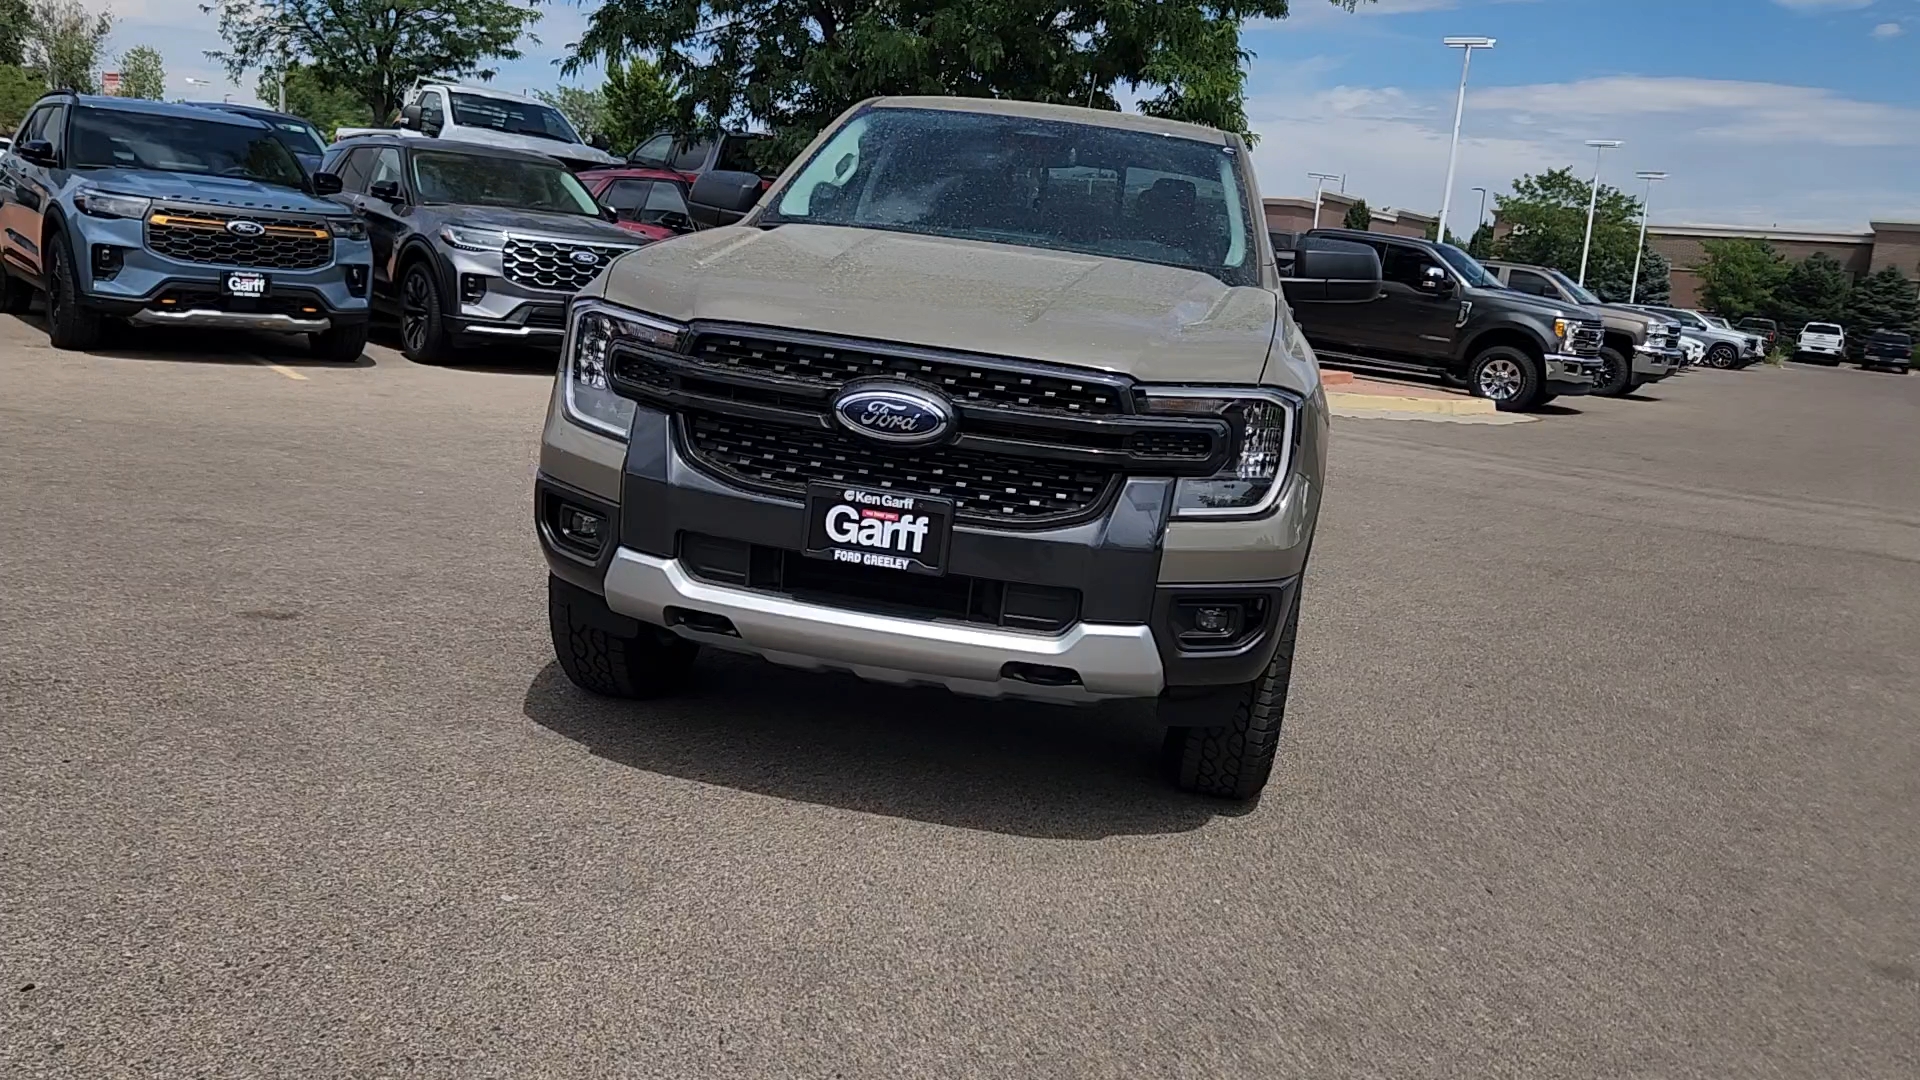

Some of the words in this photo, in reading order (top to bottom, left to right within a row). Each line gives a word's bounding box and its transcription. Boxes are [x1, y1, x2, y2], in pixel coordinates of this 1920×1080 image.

[228, 276, 265, 292] Garff
[861, 401, 920, 431] Ford
[855, 491, 880, 506] Ken
[881, 495, 914, 509] Garff
[825, 504, 929, 553] Garff
[834, 549, 861, 563] FORD
[863, 554, 909, 570] GREELEY
